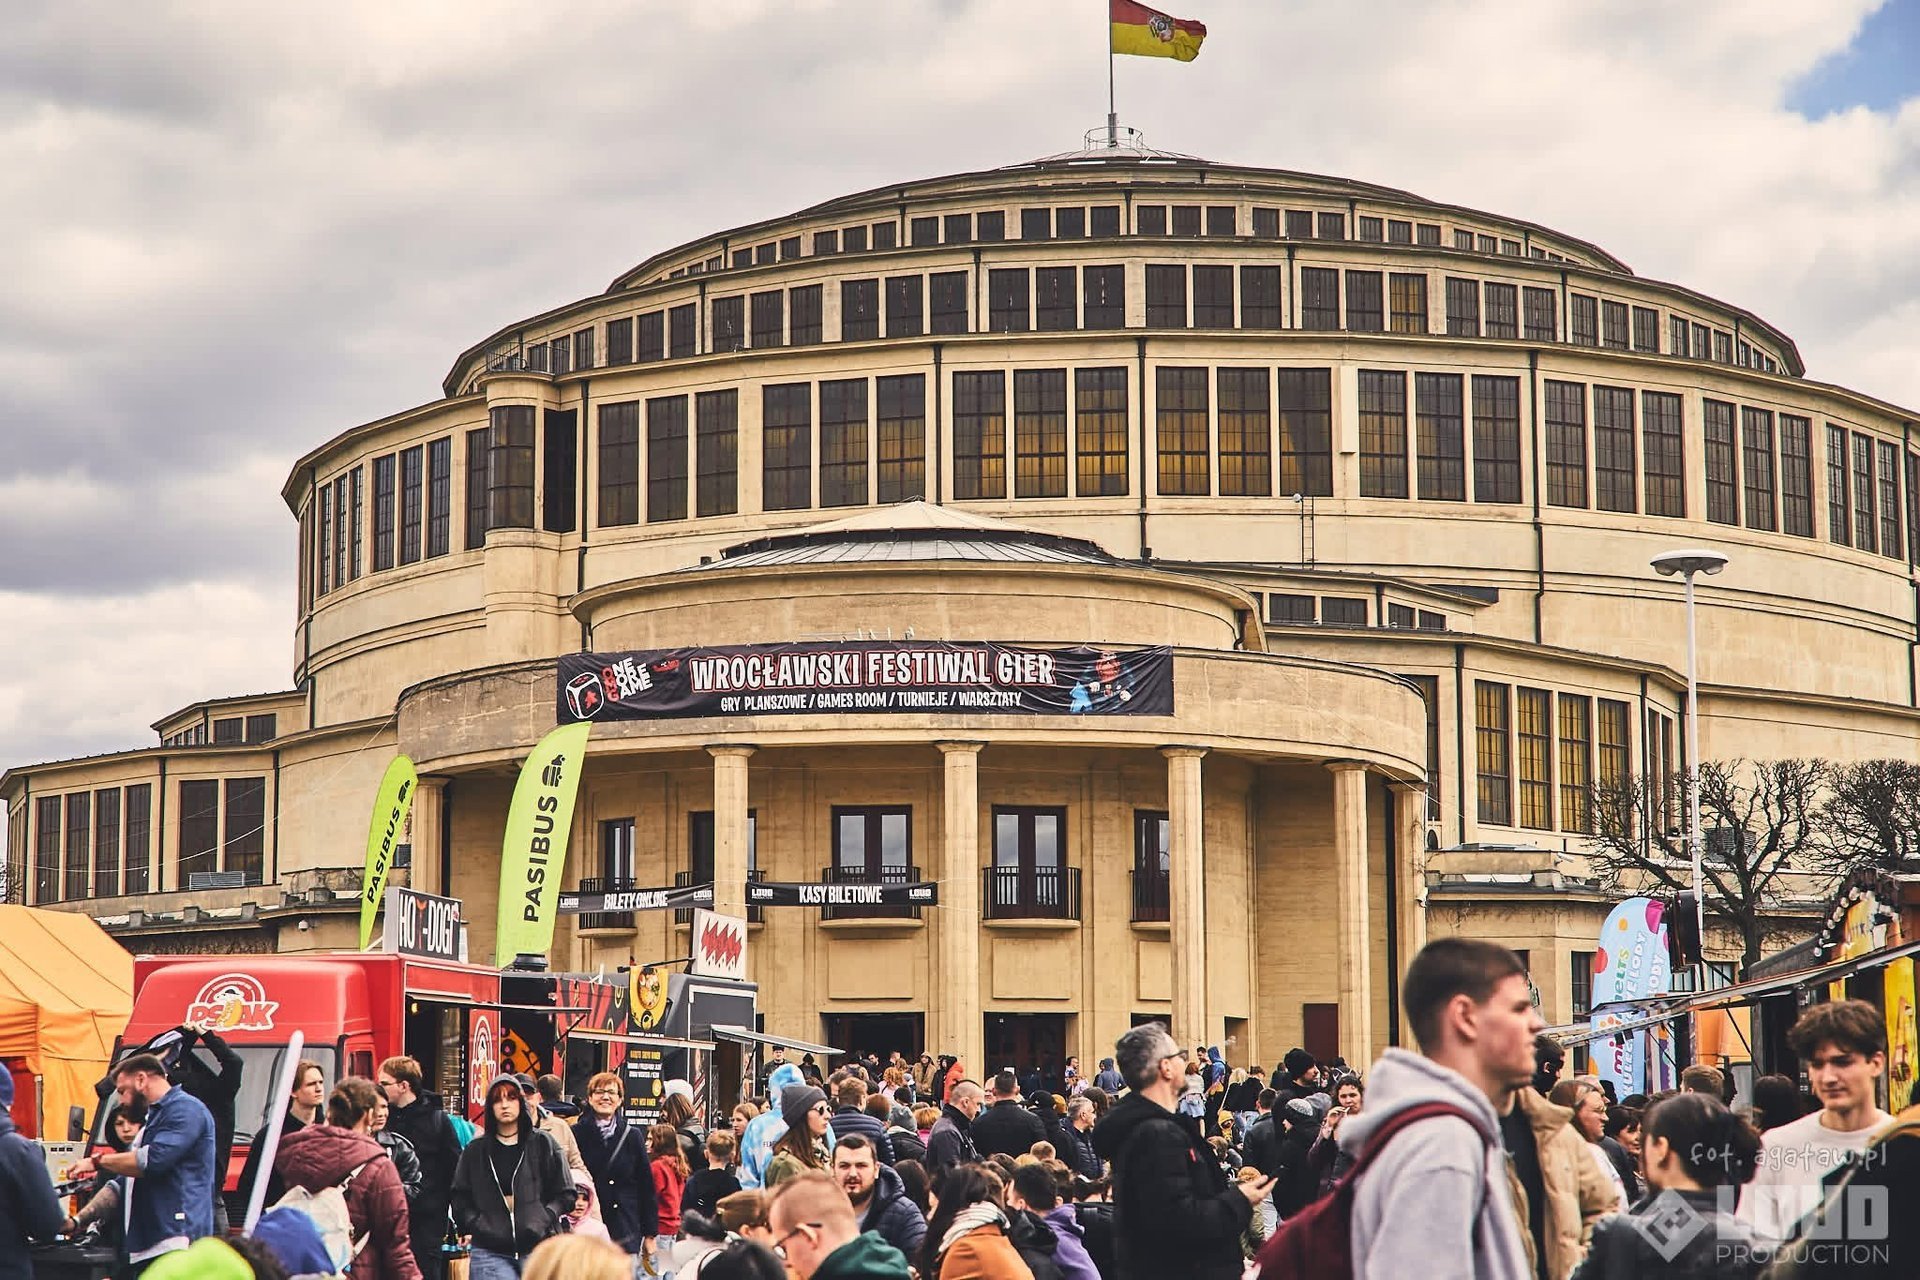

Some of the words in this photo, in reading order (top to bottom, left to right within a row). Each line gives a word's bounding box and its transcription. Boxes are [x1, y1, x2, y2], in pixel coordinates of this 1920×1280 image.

[690, 651, 862, 692] WROCŁAWSKI
[867, 651, 993, 687] FESTIWAL
[996, 651, 1056, 687] GIER
[721, 697, 741, 712] GRY
[744, 694, 807, 711] PLANSZOWE
[818, 693, 854, 709] GAMES
[855, 692, 886, 708] ROOM
[897, 691, 948, 707] TURNIEJE
[958, 691, 1022, 707] WARSZTATY
[367, 807, 401, 904] PASIBUS
[523, 796, 558, 923] PASIBUS
[603, 893, 636, 910] BILETY
[635, 890, 669, 908] ONLINE
[799, 886, 828, 904] KASY
[828, 886, 883, 904] BILETOWE
